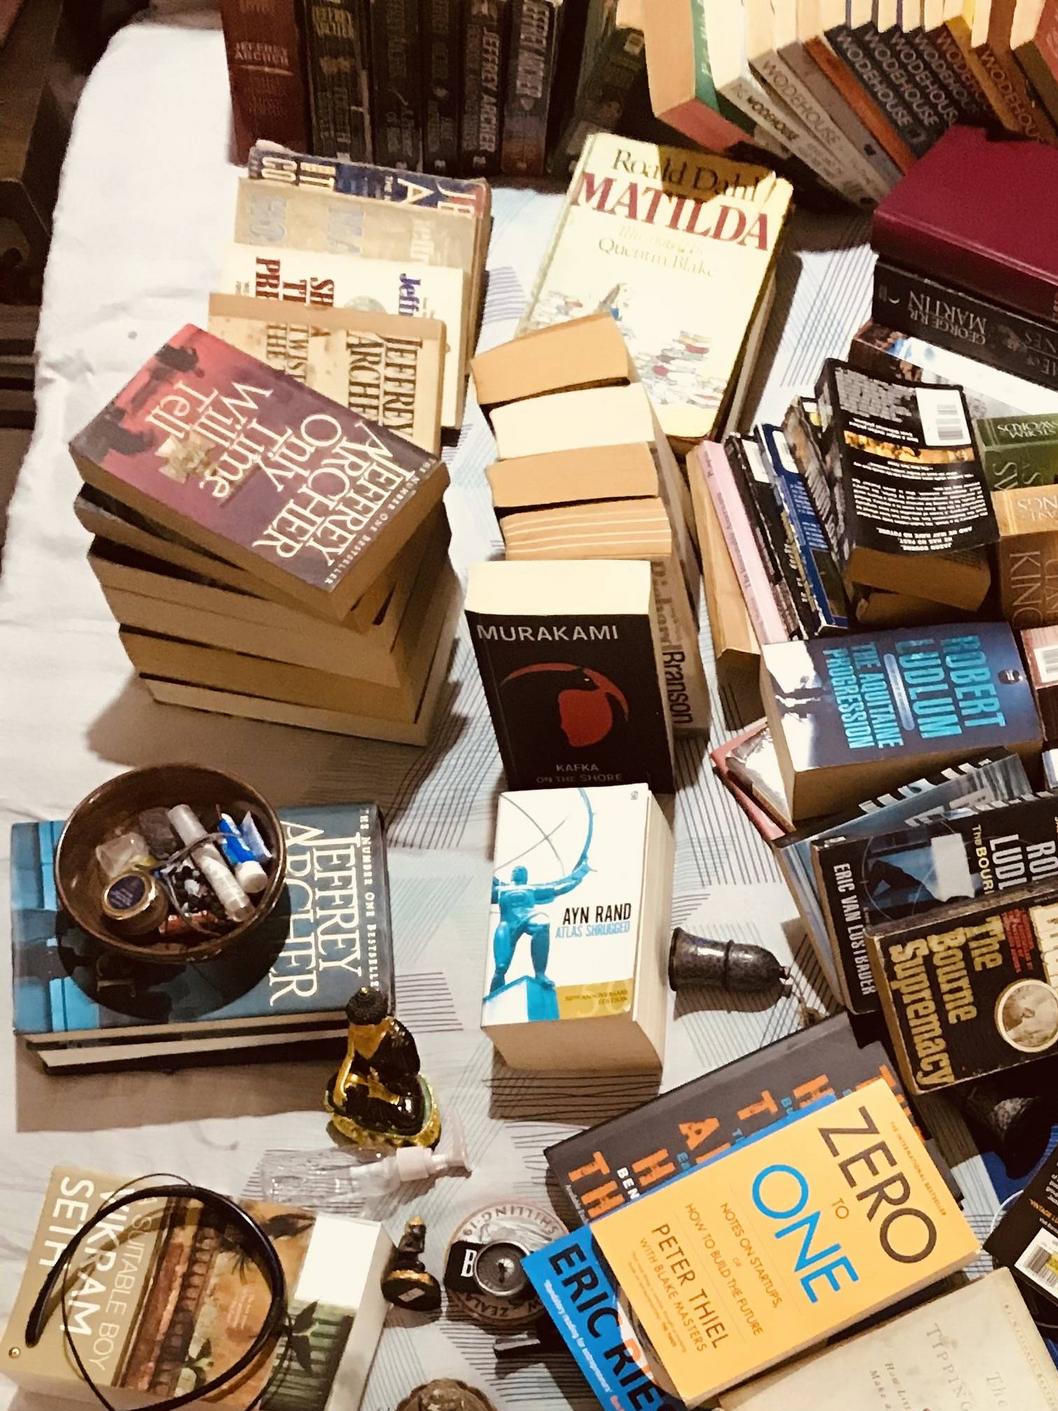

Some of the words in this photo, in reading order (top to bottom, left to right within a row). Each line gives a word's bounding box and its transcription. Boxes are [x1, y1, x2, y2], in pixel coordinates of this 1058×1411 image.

[761, 58, 841, 143] WODEHOUSE
[836, 33, 913, 127] WODEHOUSE
[864, 31, 940, 127] WODEHOUSE
[570, 172, 768, 250] MATILDA
[613, 149, 688, 186] Roald
[692, 166, 761, 200] Dahl
[598, 237, 668, 268] Quentin
[673, 254, 715, 279] Blake
[145, 380, 219, 439] Tell
[192, 382, 273, 448] Will
[200, 419, 293, 498] Time
[252, 421, 396, 559] ARCHER
[257, 414, 342, 492] Only
[305, 452, 417, 566] JEFFREY
[324, 535, 373, 584] BESTSELLER
[476, 625, 619, 642] MURAKAMI
[851, 642, 881, 668] THE
[823, 648, 876, 750] PROGRESSION
[859, 672, 904, 748] AQUITAINE
[896, 640, 962, 738] LUDLUM
[941, 636, 1006, 727] ROBERT
[556, 764, 599, 772] KAFKA
[269, 821, 325, 1007] ARCHER
[312, 832, 362, 978] JEFFREY
[563, 906, 589, 925] AYN
[595, 902, 632, 922] RAND
[833, 863, 851, 893] ERIC
[841, 893, 857, 921] VAN
[555, 925, 583, 939] ATLAS
[586, 921, 631, 936] SHRUGGED
[963, 915, 1007, 972] The
[888, 937, 956, 1088] Supremacy
[926, 927, 978, 1025] Bourne
[818, 1106, 937, 1264] ZERO
[832, 1199, 850, 1220] TO
[685, 1204, 704, 1231] HOW
[707, 1247, 731, 1281] BUILD
[725, 1280, 742, 1301] THE
[736, 1296, 764, 1336] FUTURE
[721, 1202, 747, 1242] NOTES
[749, 1253, 783, 1309] STARTUPS,
[752, 1163, 859, 1303] ONE
[548, 1243, 620, 1339] ERIC
[639, 1238, 658, 1267] WITH
[653, 1264, 678, 1299] BLAKE
[672, 1296, 708, 1352] MASTERS
[651, 1223, 696, 1287] PETER
[689, 1287, 729, 1349] THIEL
[89, 1322, 120, 1371] BOY
